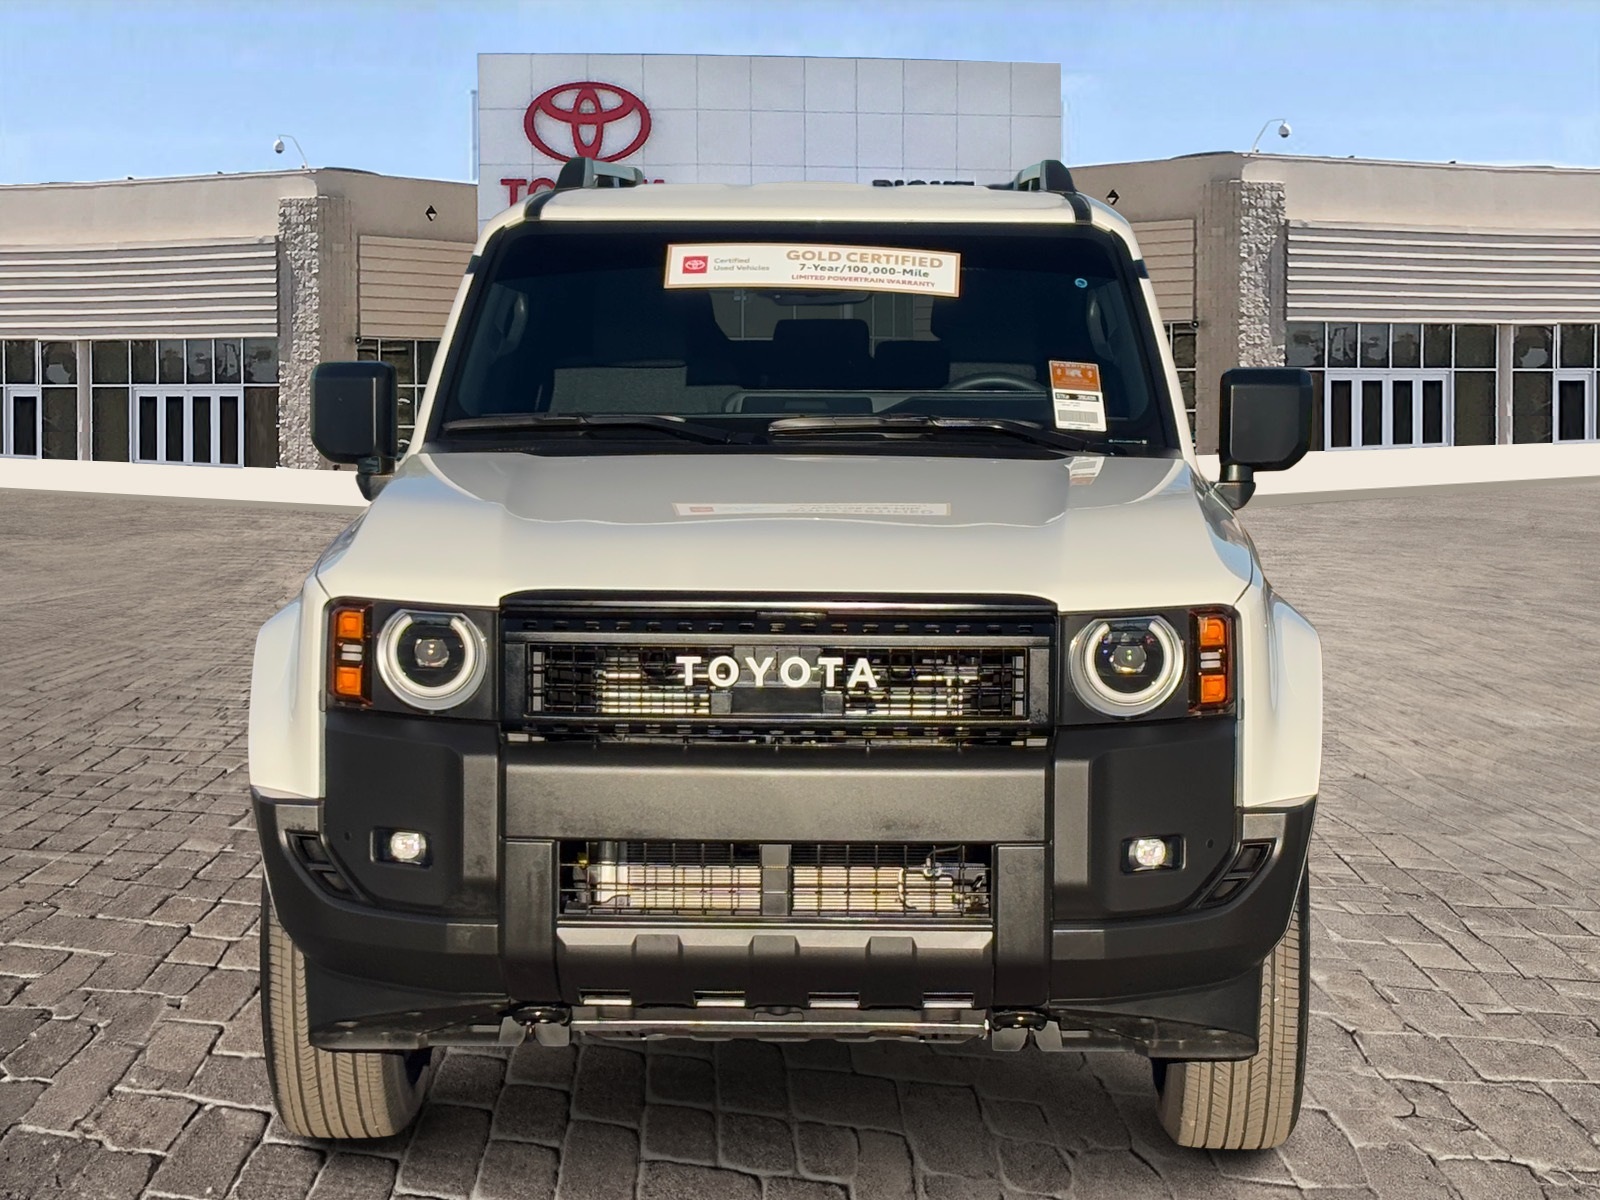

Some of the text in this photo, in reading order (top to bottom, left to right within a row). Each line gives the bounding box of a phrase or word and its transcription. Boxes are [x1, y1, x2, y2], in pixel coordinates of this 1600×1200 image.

[786, 250, 944, 269] GOLD CERTIFIED
[798, 263, 930, 278] 7-Year/100,000-Mile
[791, 274, 935, 288] LIMITED POWERTRAIN WARRANTY
[675, 655, 878, 689] TOYOTA
